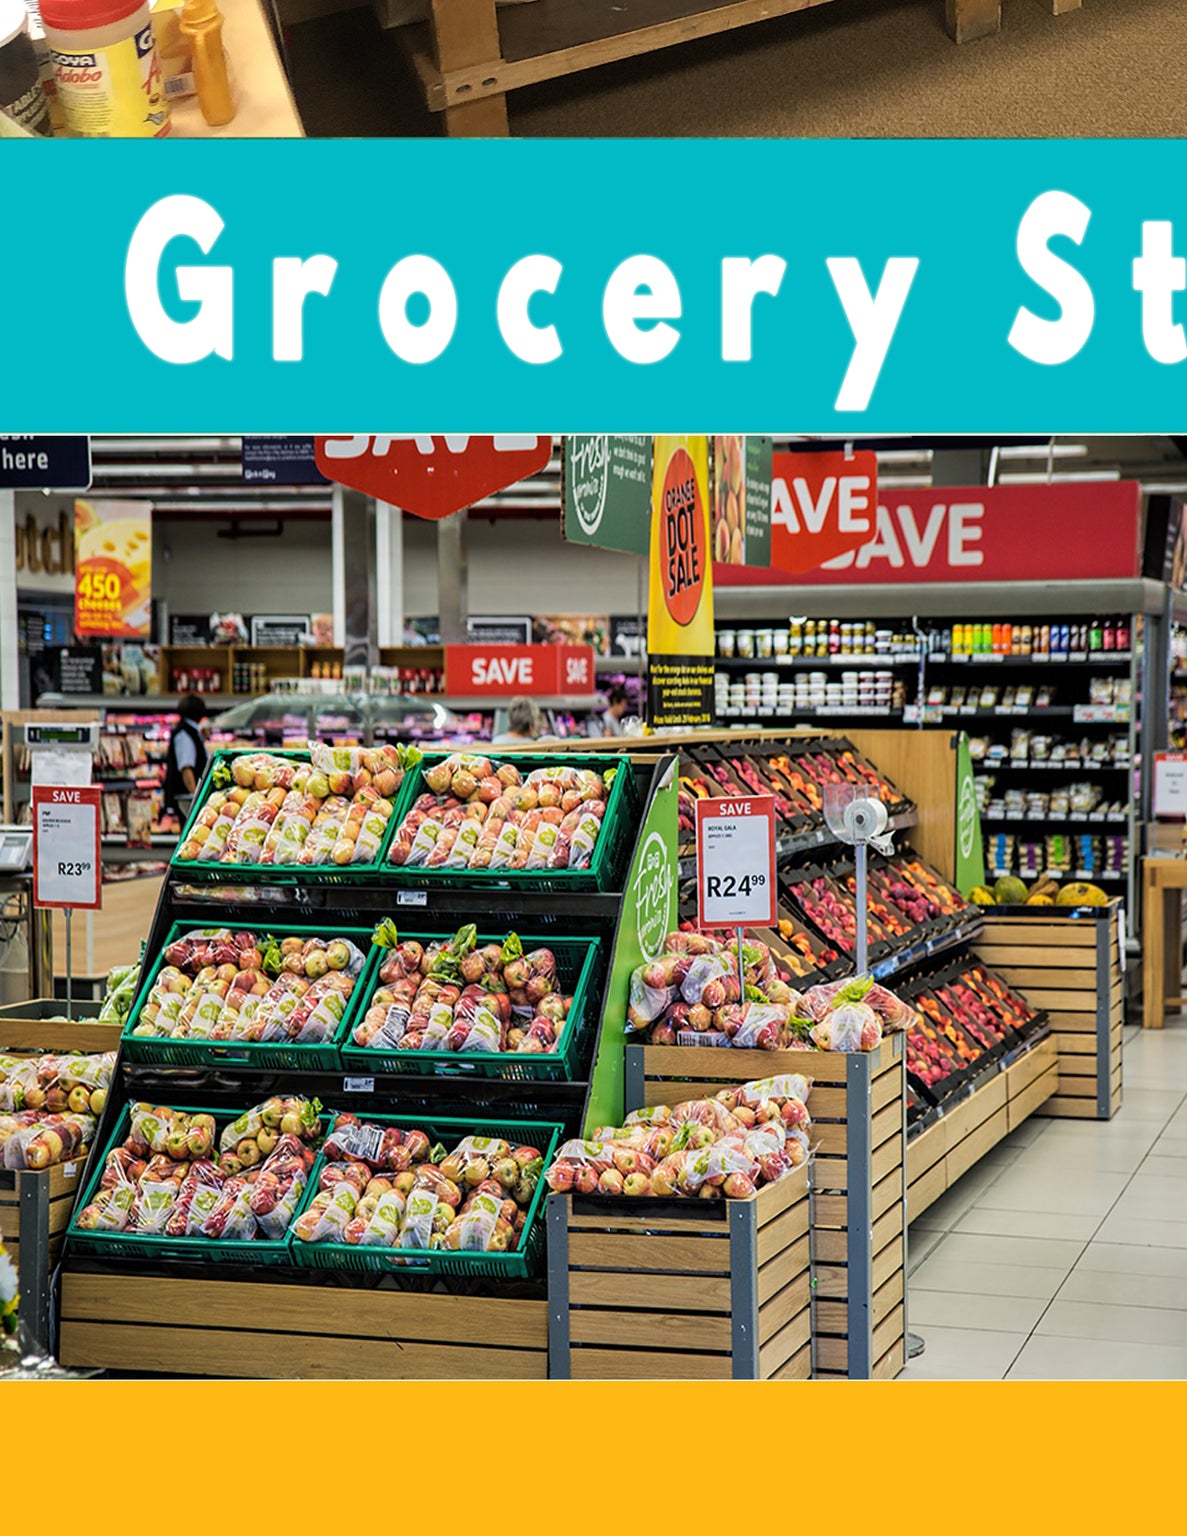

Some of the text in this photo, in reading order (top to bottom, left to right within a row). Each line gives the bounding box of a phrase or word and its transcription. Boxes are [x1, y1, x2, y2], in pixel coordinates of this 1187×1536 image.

[51, 53, 95, 67] GOYA
[54, 66, 102, 84] Adobo
[1, 449, 49, 470] here
[665, 478, 696, 513] ORANGE
[667, 503, 697, 559] DOT
[668, 546, 701, 598] SALE
[77, 575, 122, 599] 450
[471, 657, 534, 686] SAVE
[565, 657, 588, 685] SAVE
[52, 790, 81, 803] SAVE
[720, 802, 752, 815] SAVE
